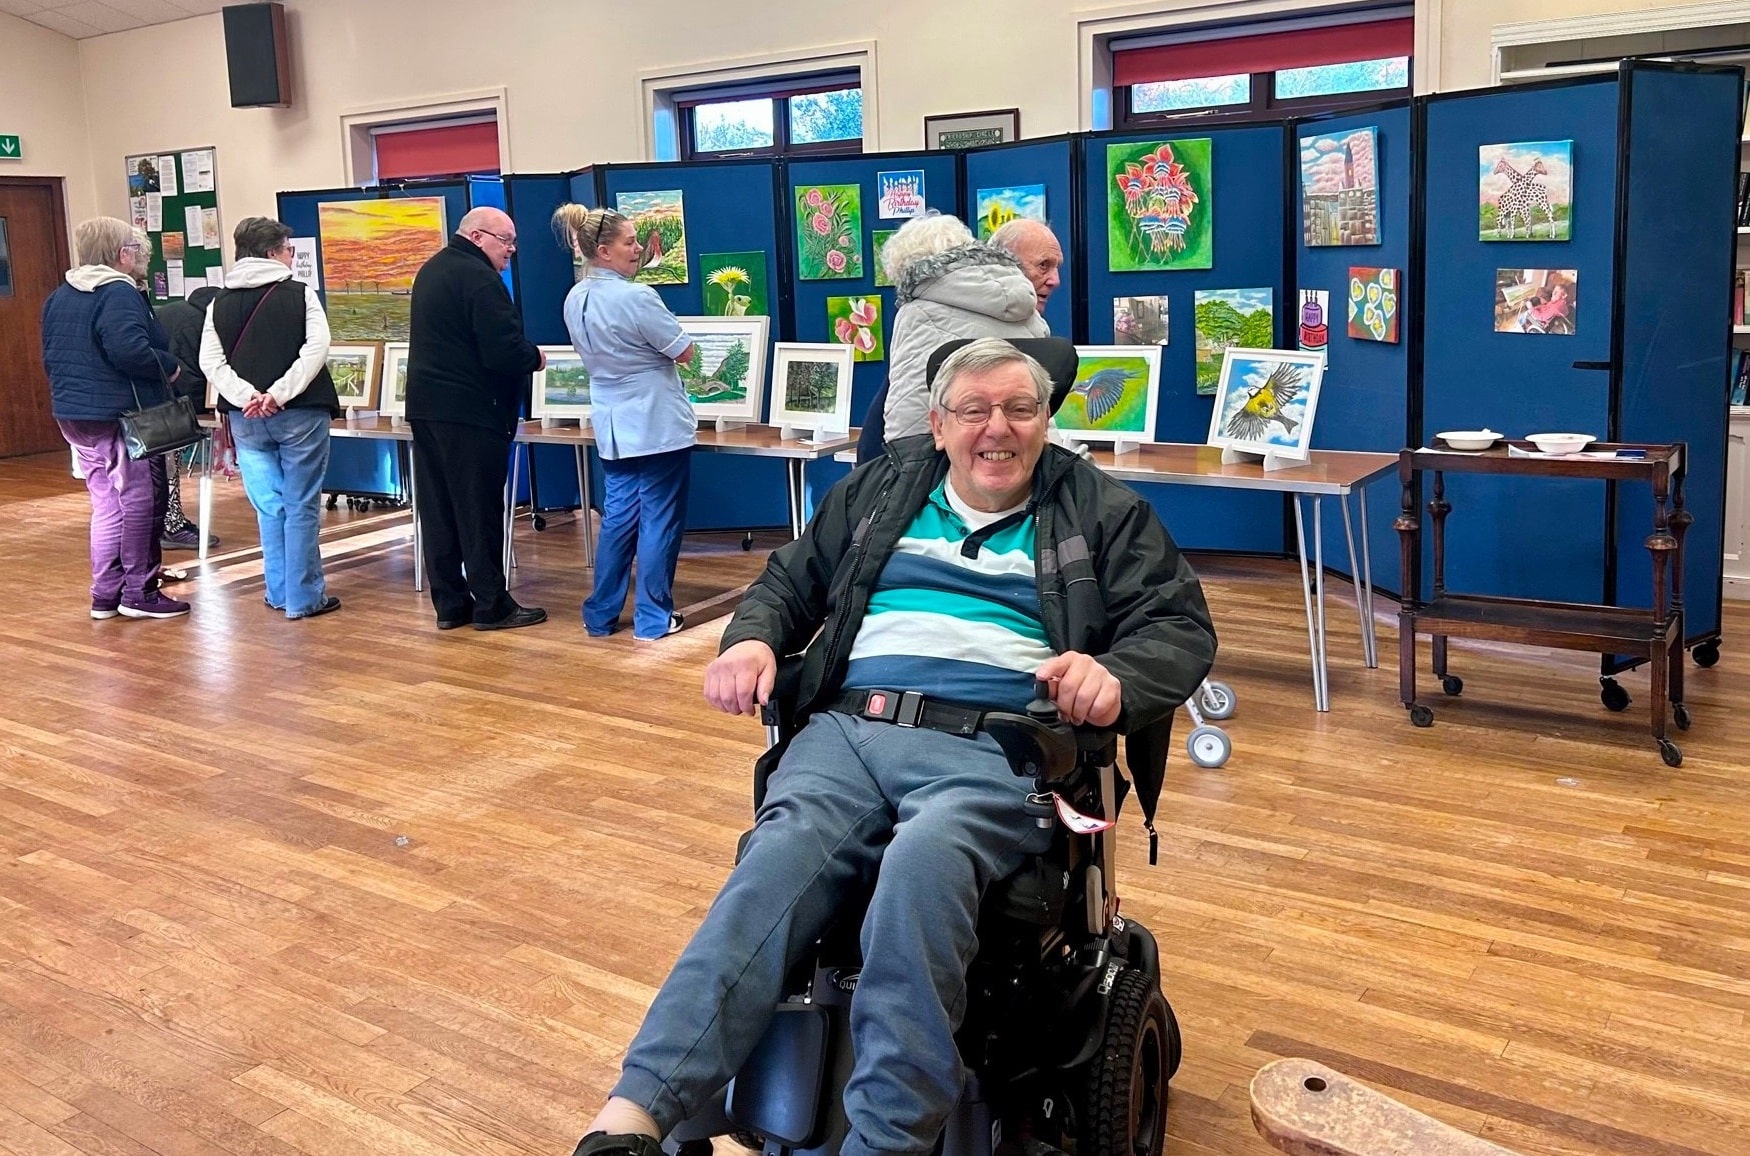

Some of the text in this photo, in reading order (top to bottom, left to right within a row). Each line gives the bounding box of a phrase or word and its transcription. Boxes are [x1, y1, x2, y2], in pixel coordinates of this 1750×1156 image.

[886, 189, 911, 199] Happy
[883, 197, 919, 211] Birthday
[296, 251, 310, 260] HAPPY
[1304, 311, 1319, 323] HAPPY
[839, 980, 856, 990] QUI
